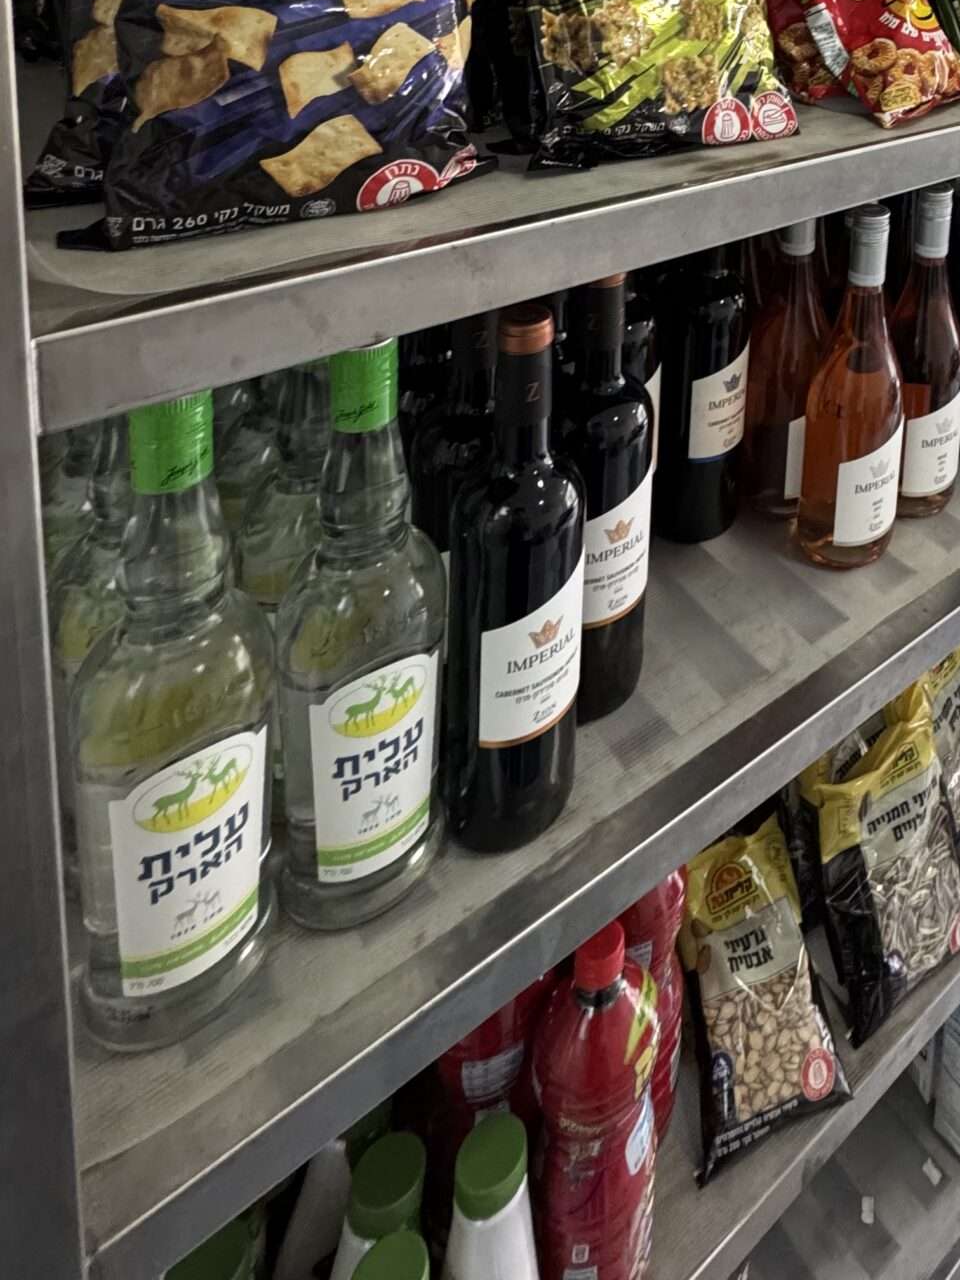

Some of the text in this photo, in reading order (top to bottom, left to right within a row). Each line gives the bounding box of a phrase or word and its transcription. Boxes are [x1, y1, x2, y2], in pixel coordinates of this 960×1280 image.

[131, 215, 167, 233] גרם
[172, 214, 207, 231] 260
[212, 207, 239, 227] נקי
[242, 200, 291, 220] משקל
[527, 381, 542, 403] Z
[506, 626, 576, 675] IMPERIAL
[331, 717, 425, 780] עלית
[340, 745, 419, 803] הארק
[137, 801, 250, 882] עלית
[147, 833, 244, 906] הארק
[727, 945, 775, 973] אבטיח
